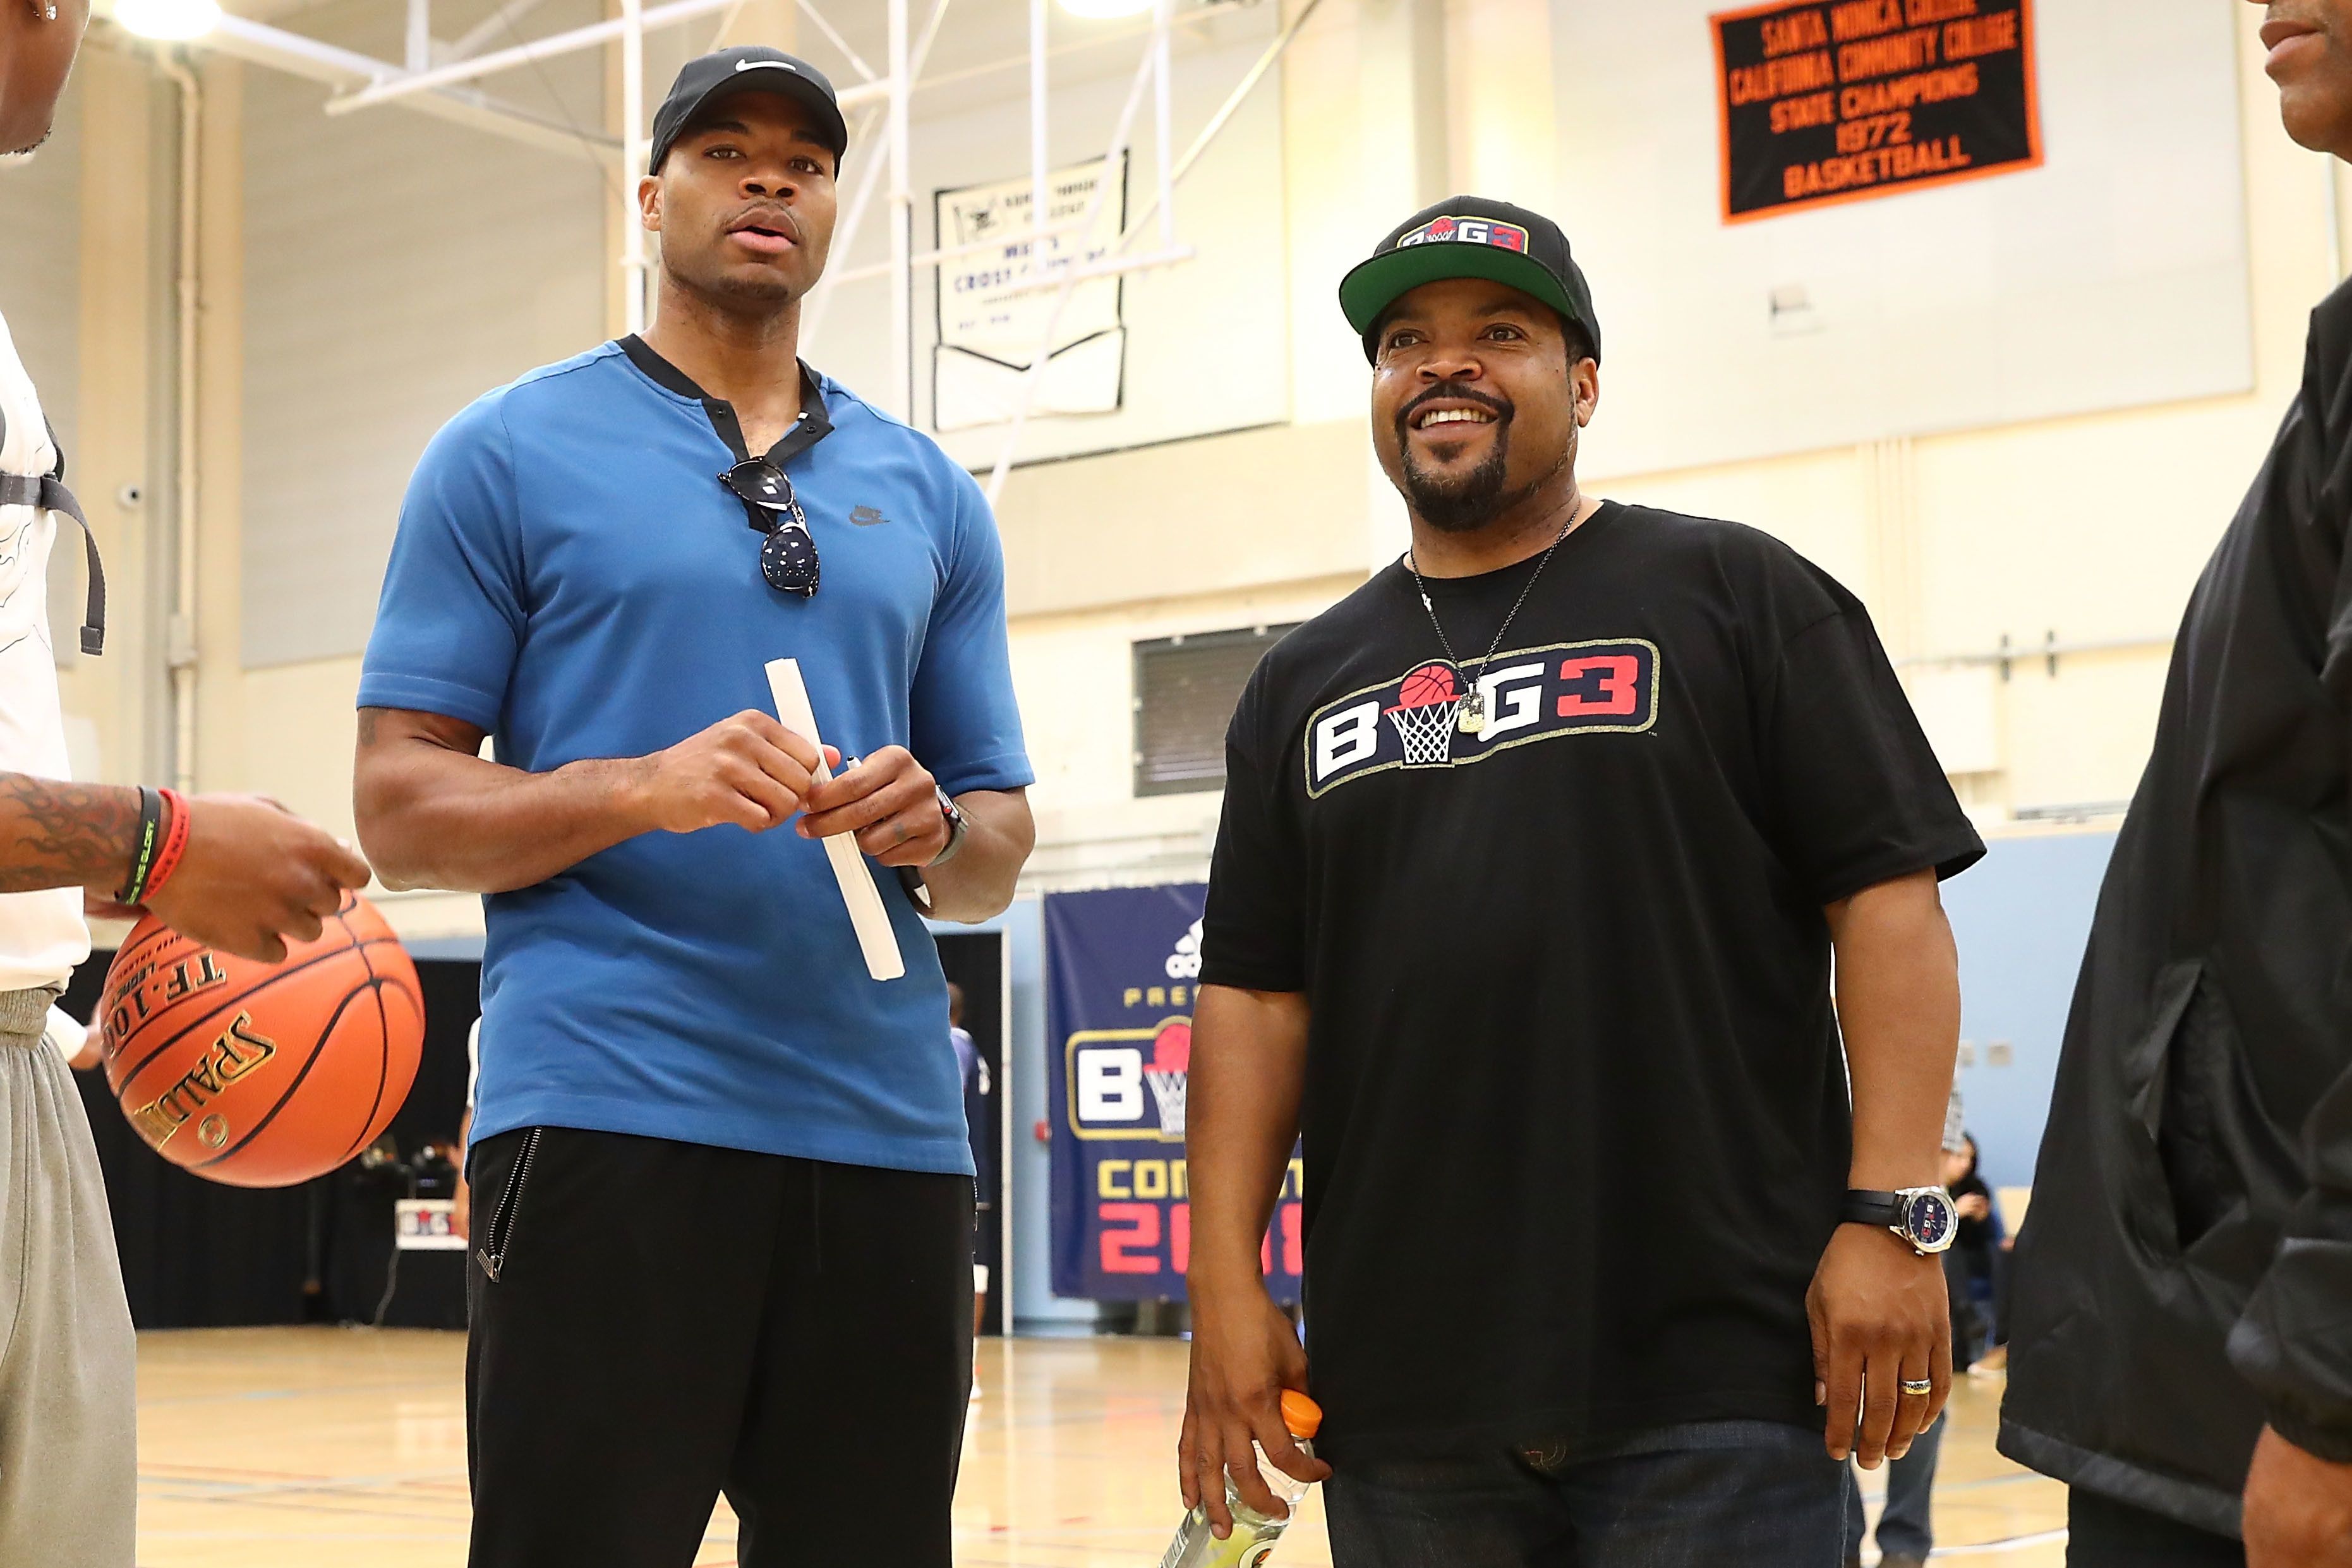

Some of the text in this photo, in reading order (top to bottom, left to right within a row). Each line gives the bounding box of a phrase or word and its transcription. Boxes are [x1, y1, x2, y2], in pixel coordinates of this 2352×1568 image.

[1770, 62, 1979, 135] STATE CHAMPIONS
[1835, 111, 1912, 154] 1972
[1783, 134, 1972, 200] BASKETBALL
